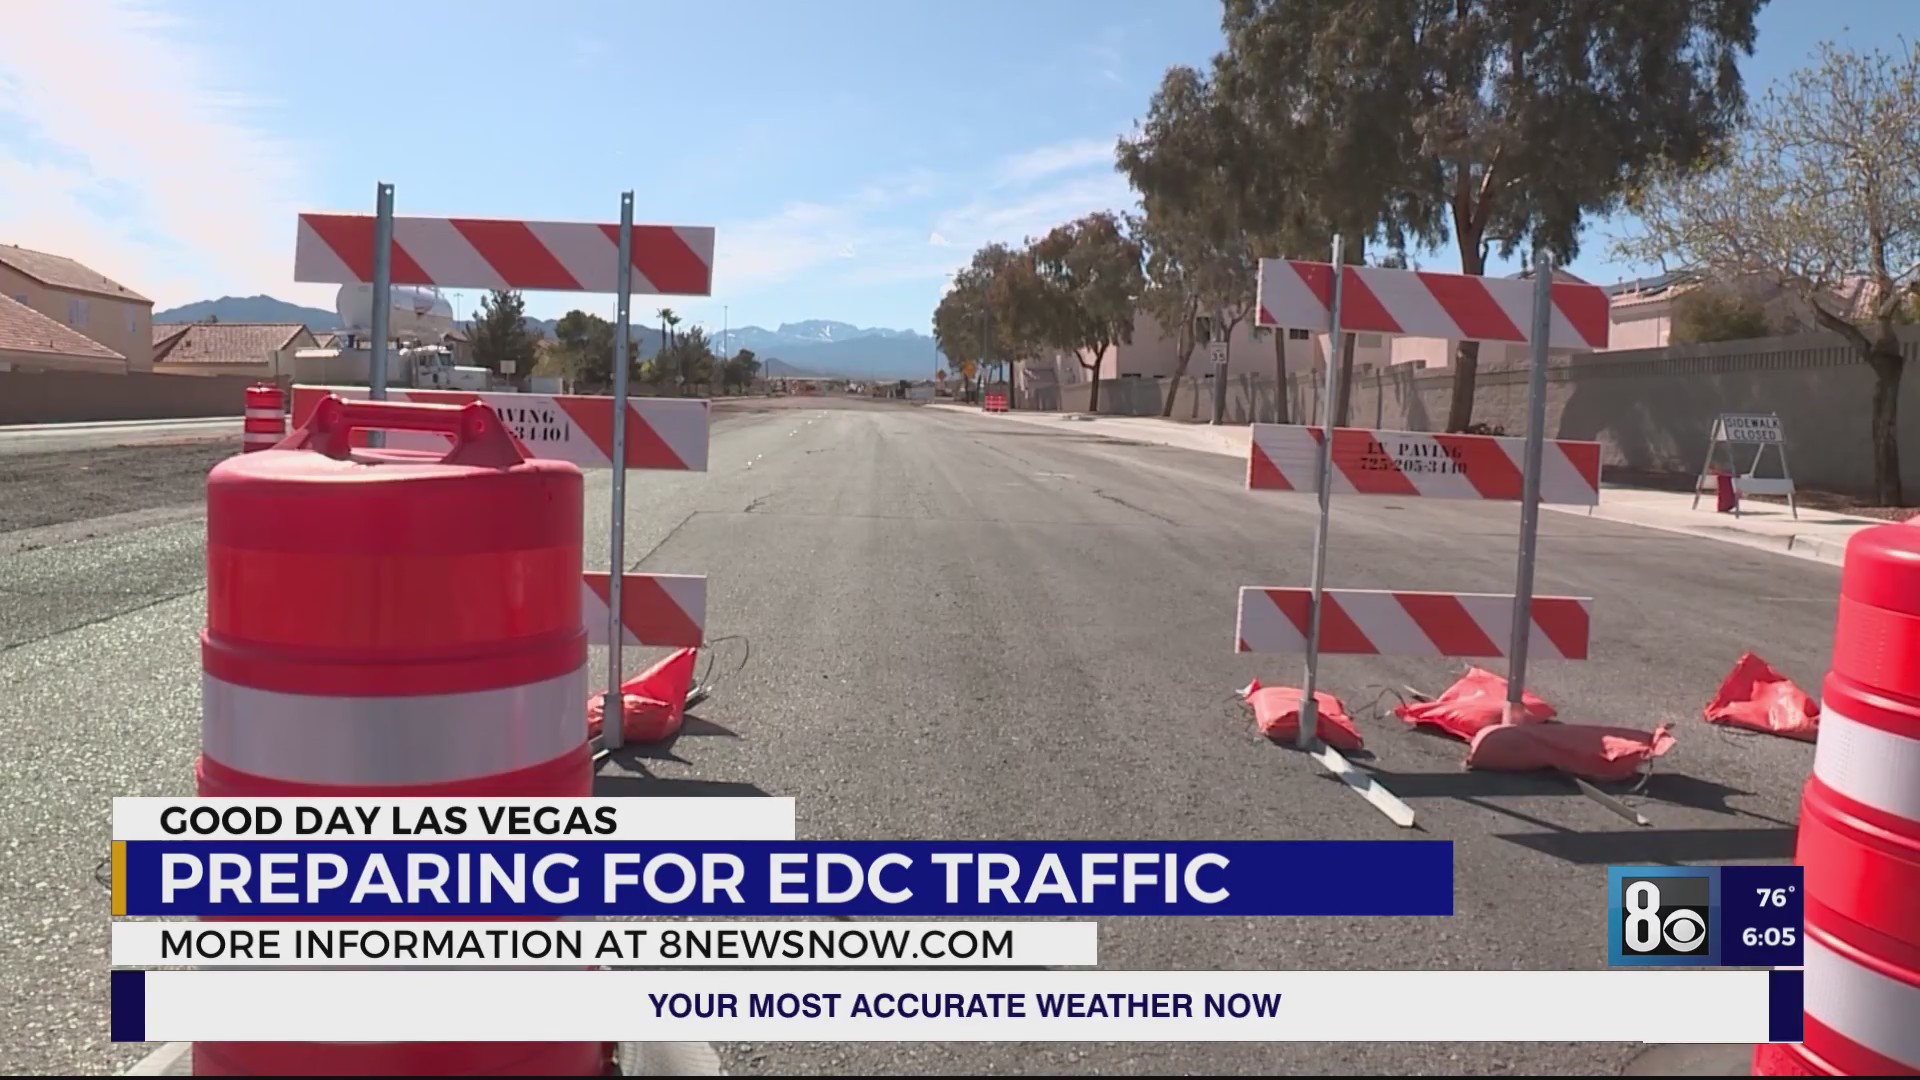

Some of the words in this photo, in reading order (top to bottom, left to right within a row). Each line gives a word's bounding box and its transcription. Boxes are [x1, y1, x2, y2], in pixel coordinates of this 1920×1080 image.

[1727, 417, 1778, 429] SIDEWALK
[1733, 428, 1777, 441] CLOSED
[1398, 442, 1463, 458] PAVING
